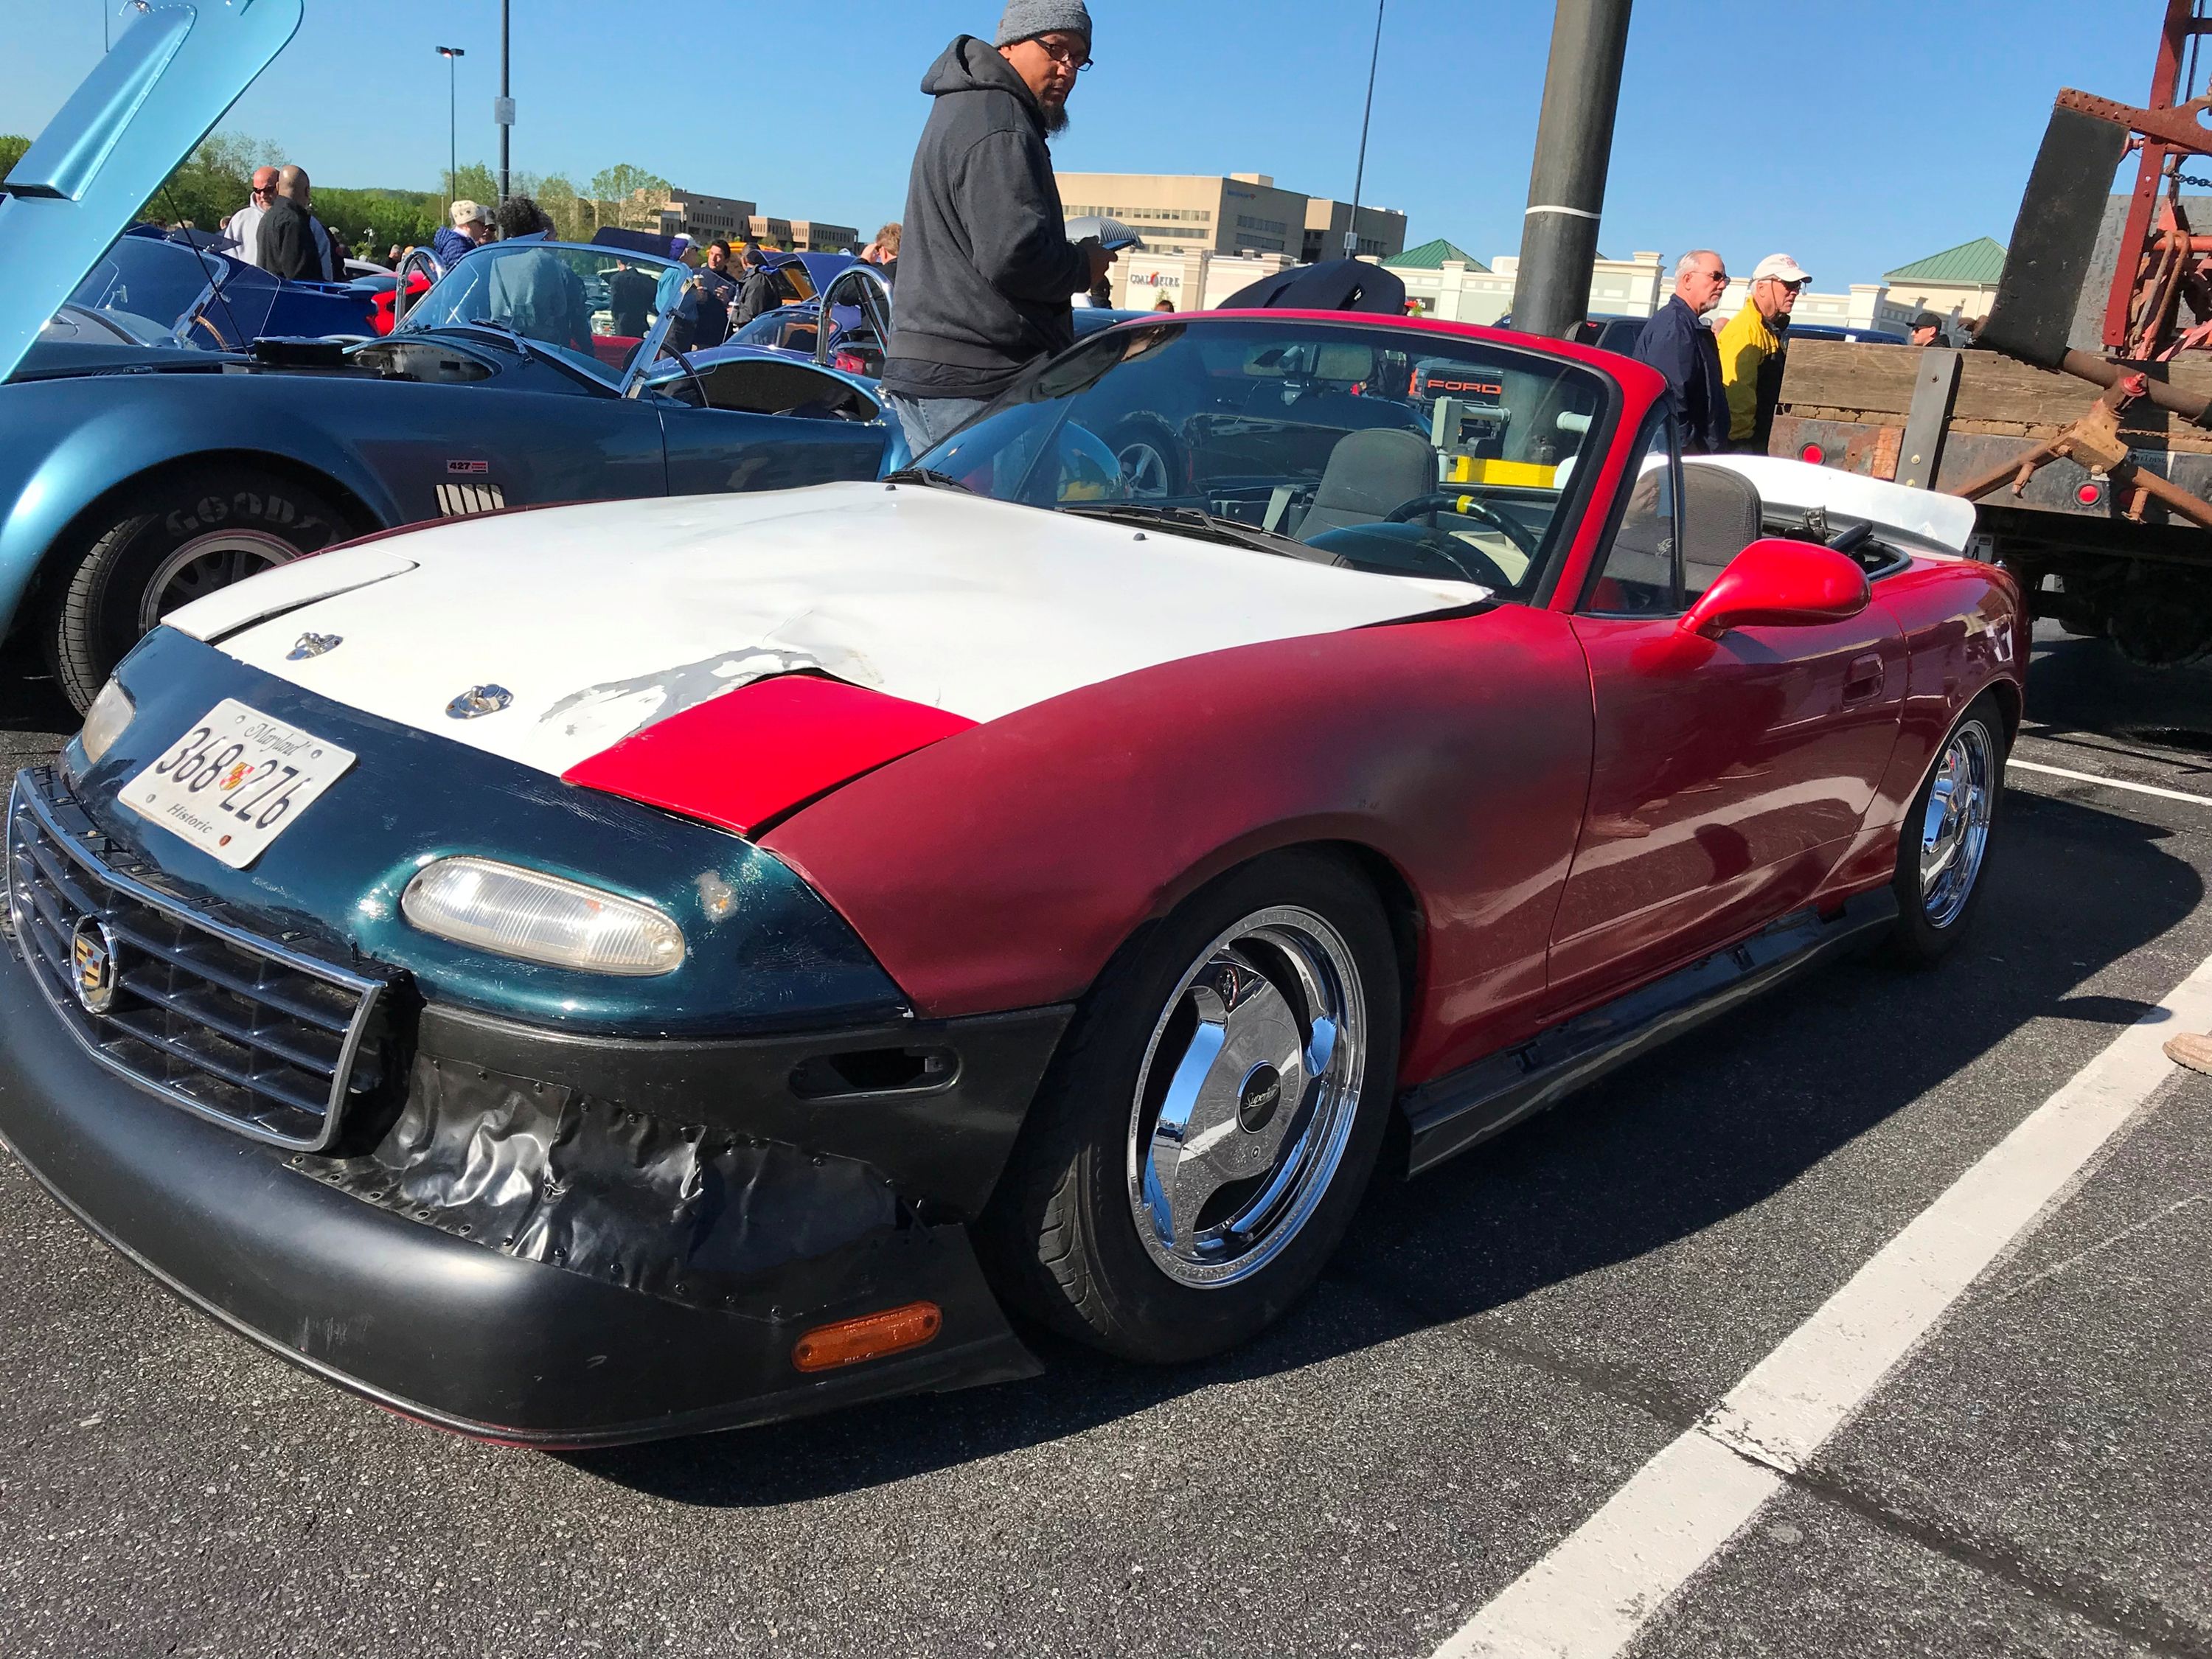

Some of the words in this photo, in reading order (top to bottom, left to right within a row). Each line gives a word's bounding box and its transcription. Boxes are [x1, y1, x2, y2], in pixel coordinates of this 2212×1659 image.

[1427, 379, 1502, 394] FORD
[449, 462, 470, 470] 427
[243, 723, 308, 757] Maryland
[167, 803, 213, 834] Historic
[1242, 1083, 1279, 1110] Superior
